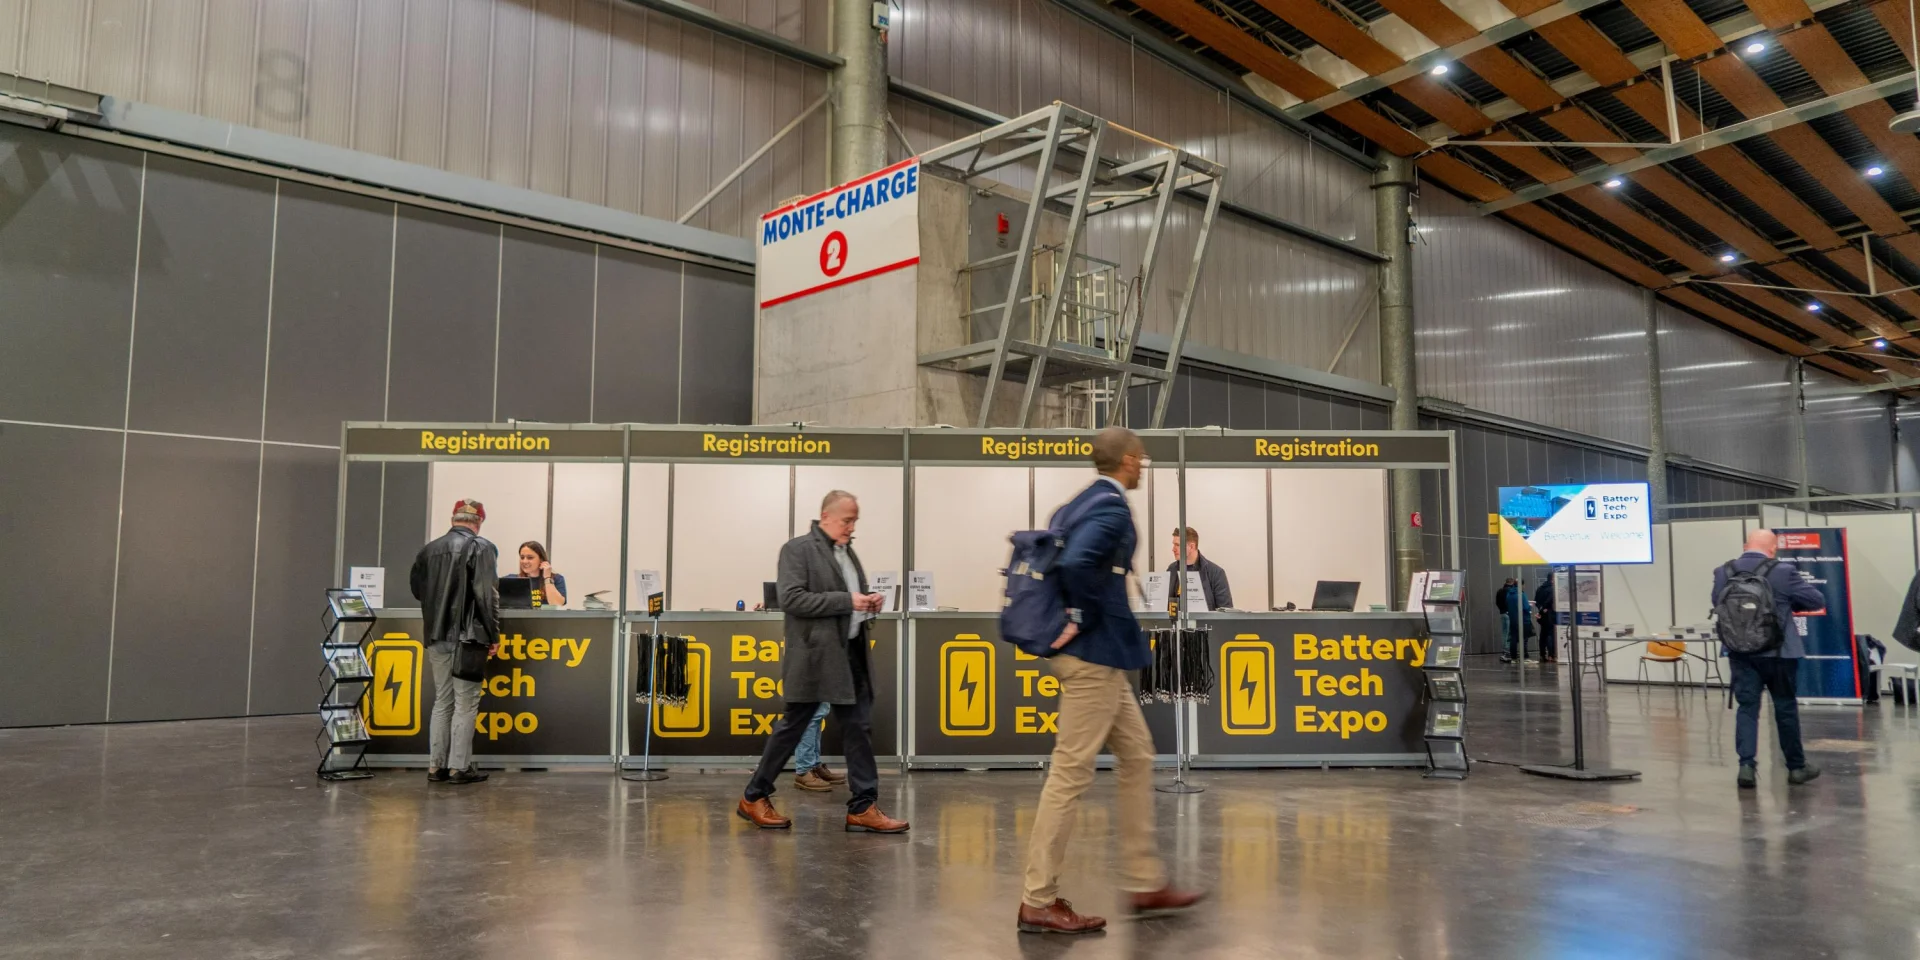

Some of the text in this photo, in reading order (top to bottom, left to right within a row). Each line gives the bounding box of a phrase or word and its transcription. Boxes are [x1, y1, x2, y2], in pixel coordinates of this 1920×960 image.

[762, 165, 918, 246] MONTE-CHARGE
[825, 239, 842, 269] 2
[420, 430, 551, 455] Registration
[702, 432, 831, 458] Registration
[982, 436, 1094, 460] Registratio
[1254, 438, 1379, 462] Registration
[1602, 494, 1640, 503] Battery
[1603, 512, 1628, 520] Expo
[1600, 530, 1644, 540] Welcome
[496, 633, 592, 668] ttery
[1293, 633, 1433, 668] Battery
[730, 671, 785, 699] Te
[1014, 669, 1065, 698] Te
[1294, 668, 1384, 697] Tech
[474, 711, 539, 741] xpo
[1014, 705, 1060, 734] Ex
[1294, 705, 1388, 740] Expo
